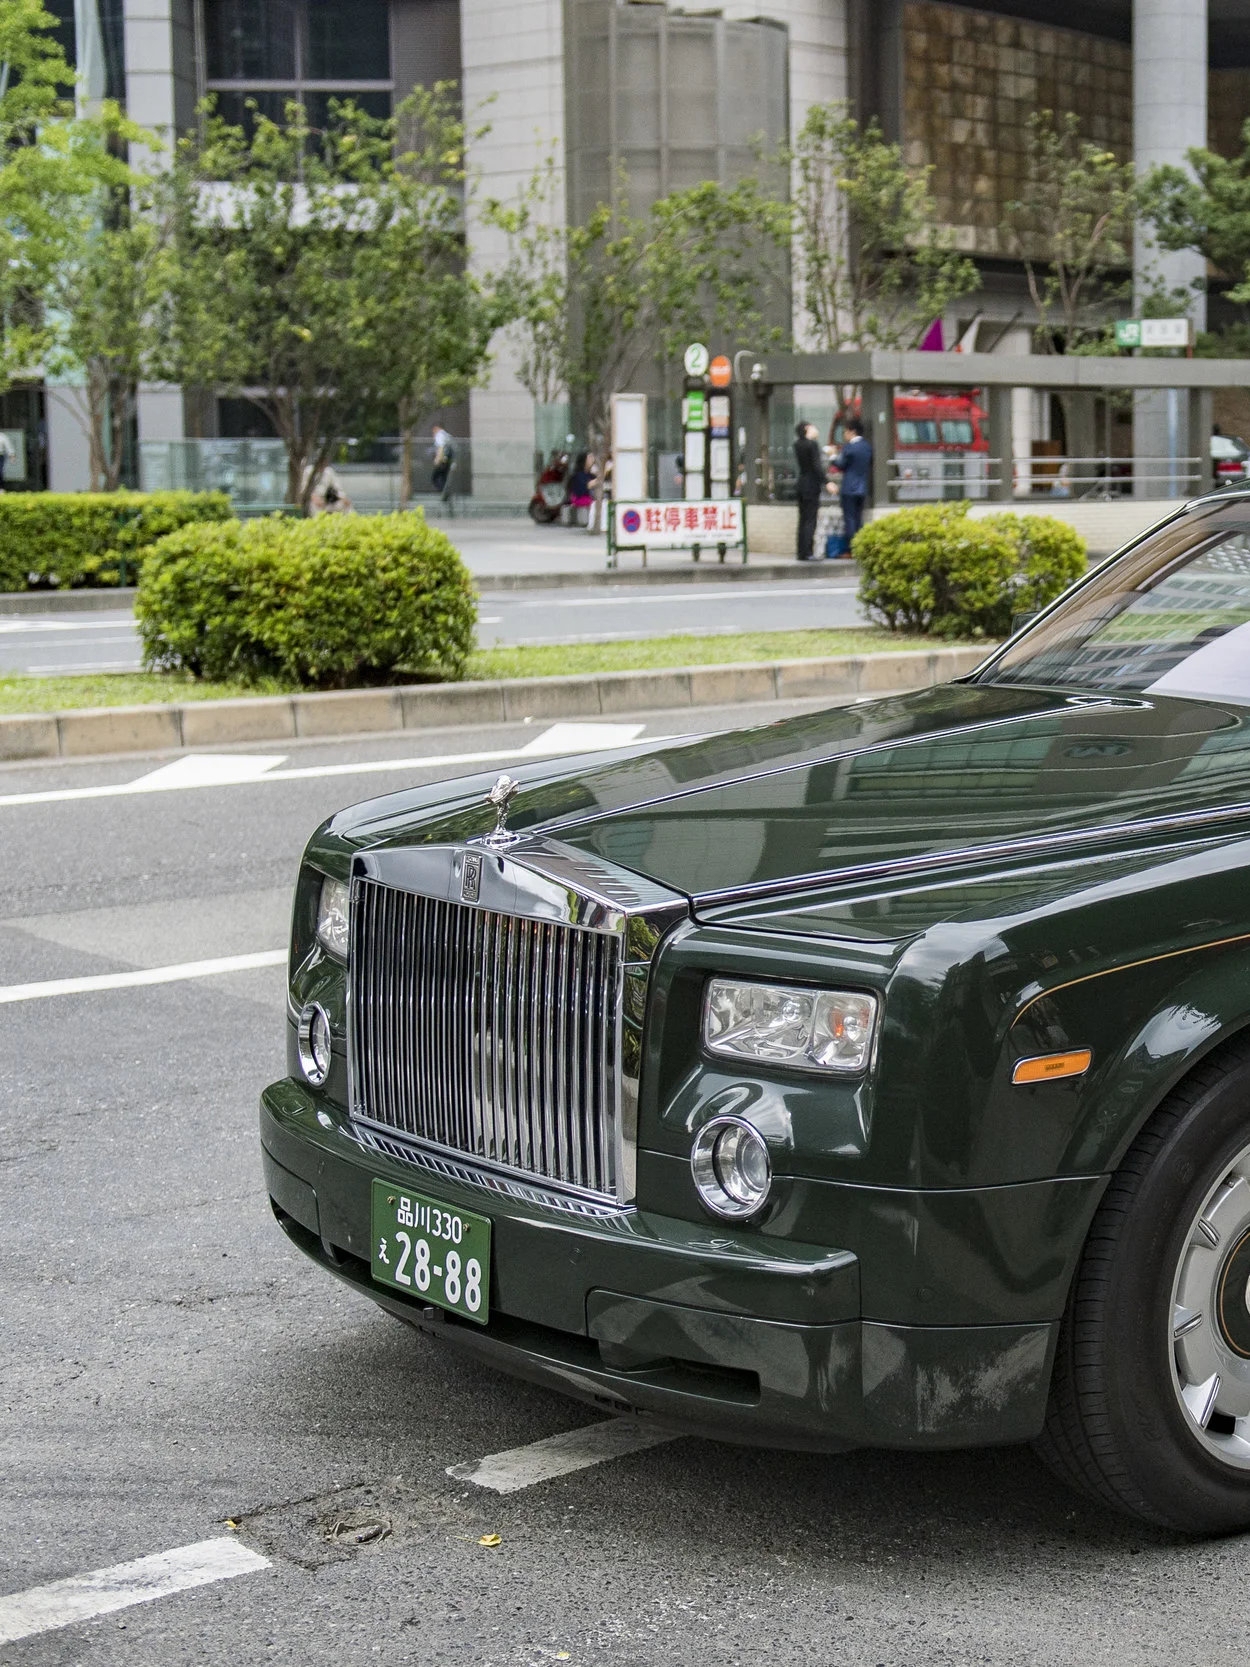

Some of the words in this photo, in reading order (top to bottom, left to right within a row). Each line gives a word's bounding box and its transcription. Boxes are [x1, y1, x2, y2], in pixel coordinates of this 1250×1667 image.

[691, 347, 701, 368] 2
[645, 505, 737, 532] 駐停車禁止
[378, 1237, 390, 1265] え
[395, 1231, 482, 1313] 28-88
